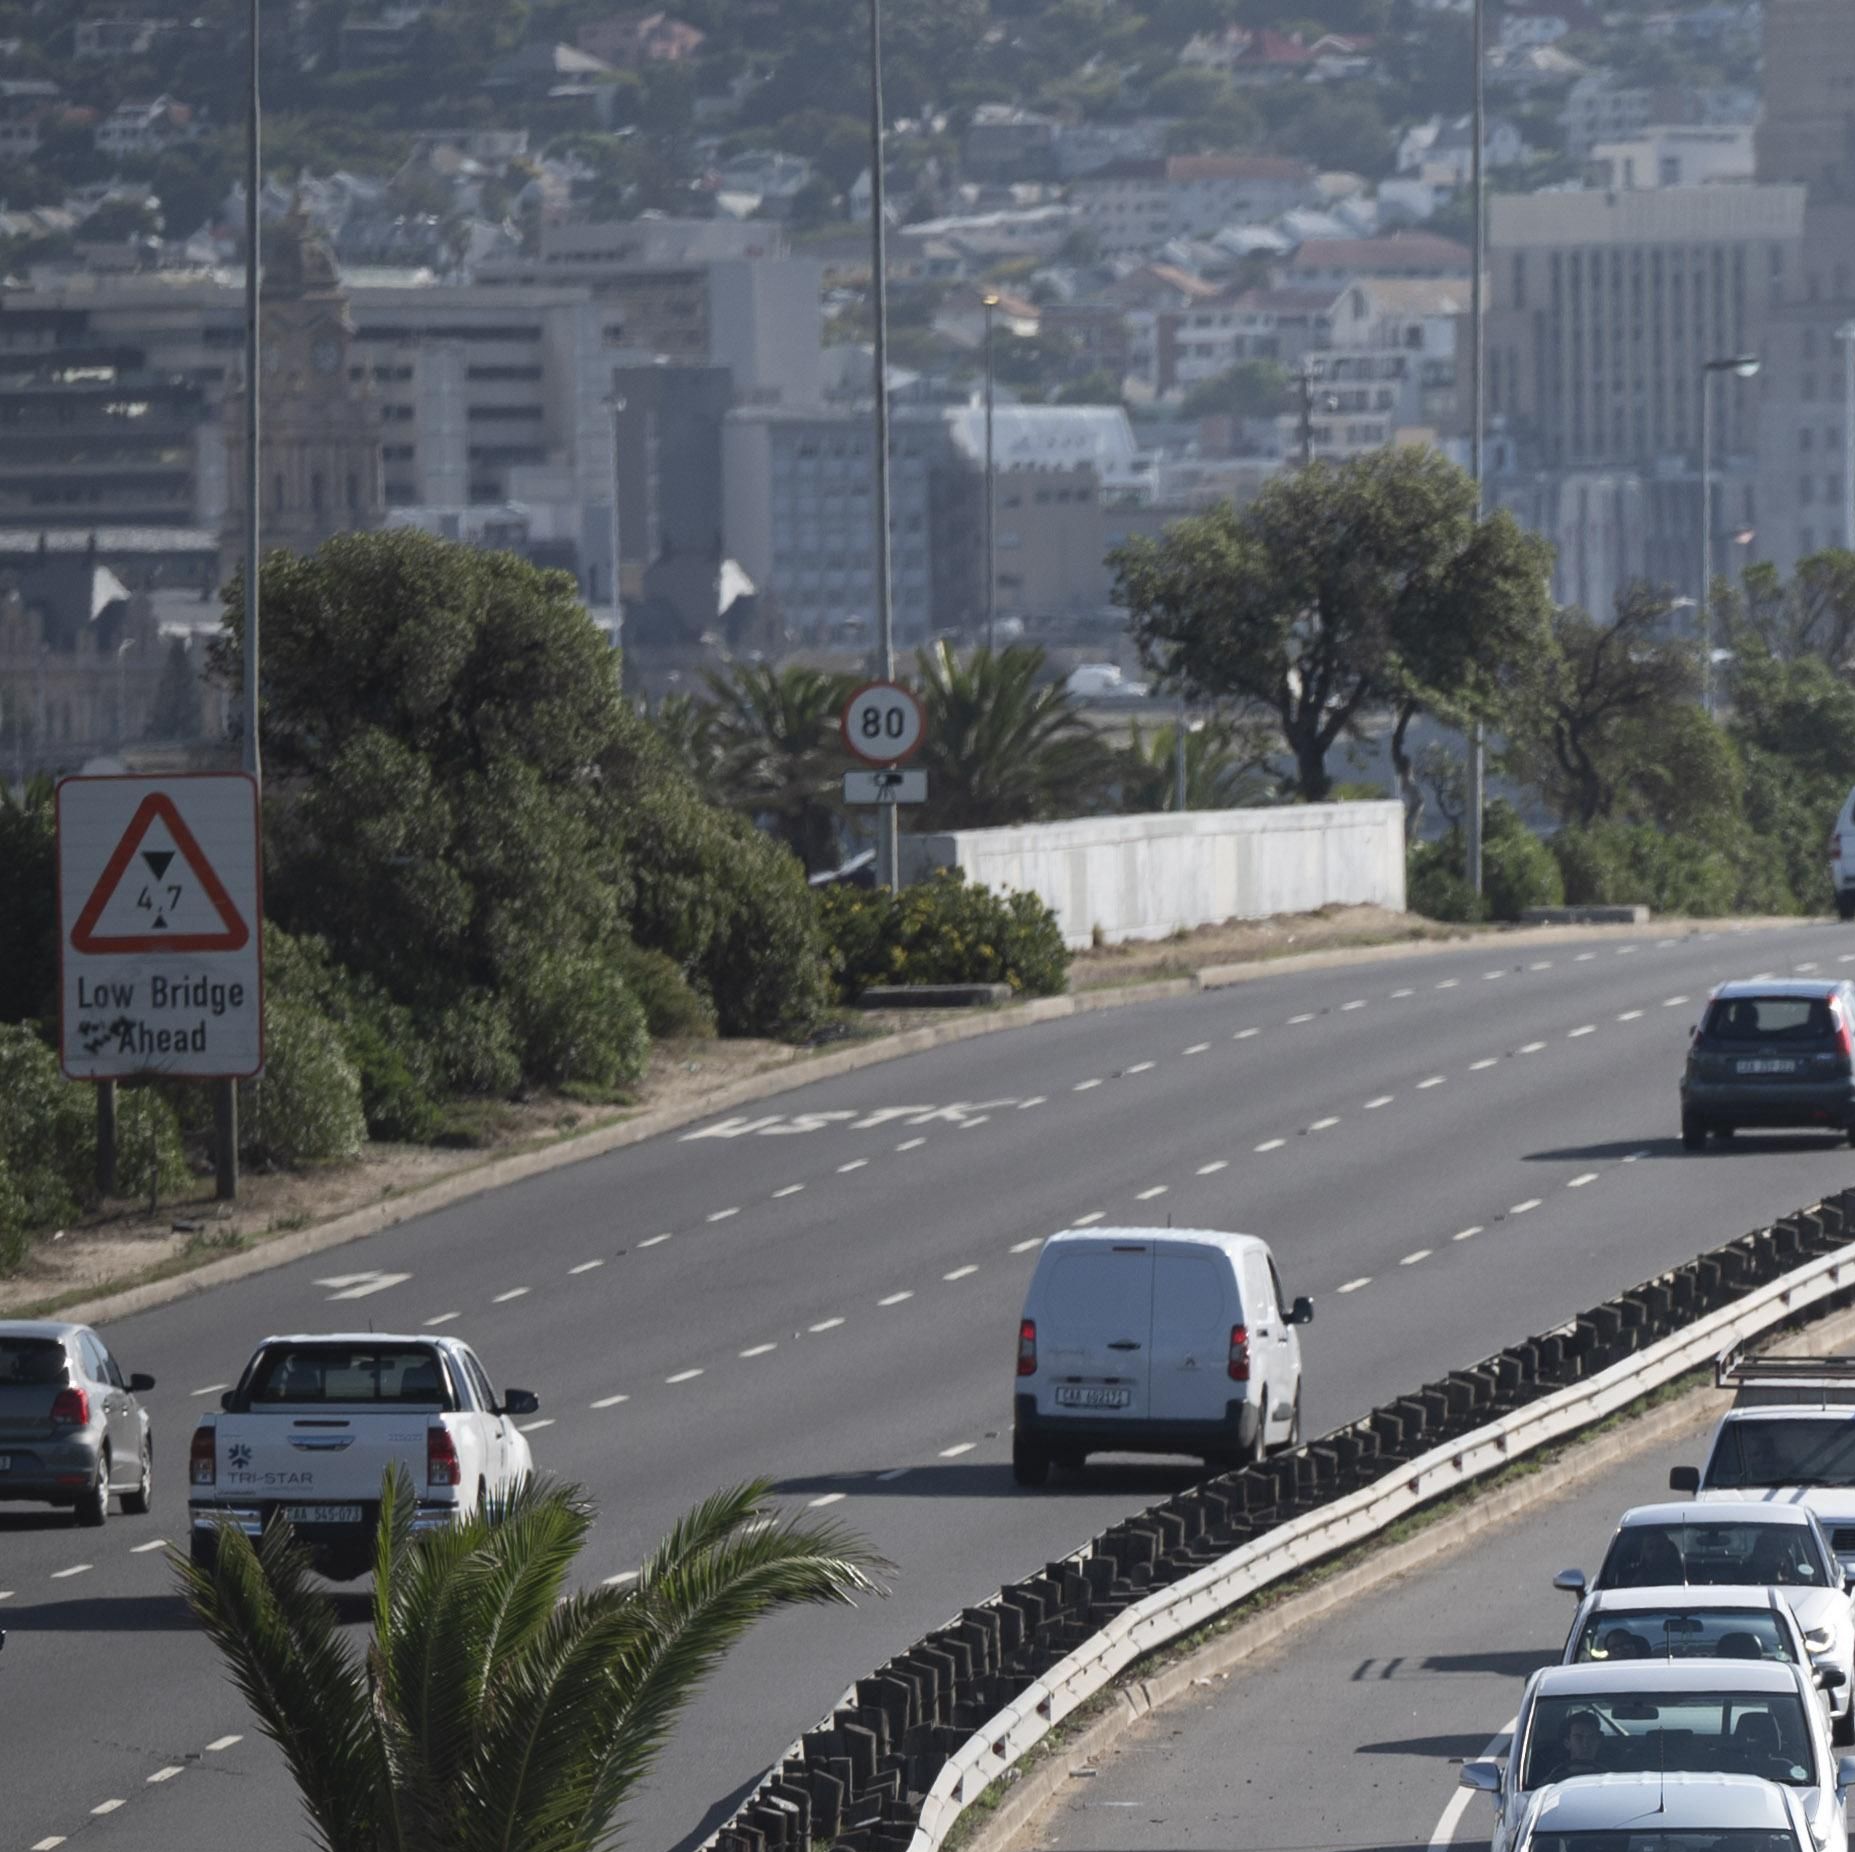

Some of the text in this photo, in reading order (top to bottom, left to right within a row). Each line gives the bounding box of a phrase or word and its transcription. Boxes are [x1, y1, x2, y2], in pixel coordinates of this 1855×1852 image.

[862, 706, 904, 739] 80
[78, 975, 244, 1016] Low Bridge
[118, 1018, 206, 1053] Ahead
[227, 1471, 313, 1485] TRI-STAR
